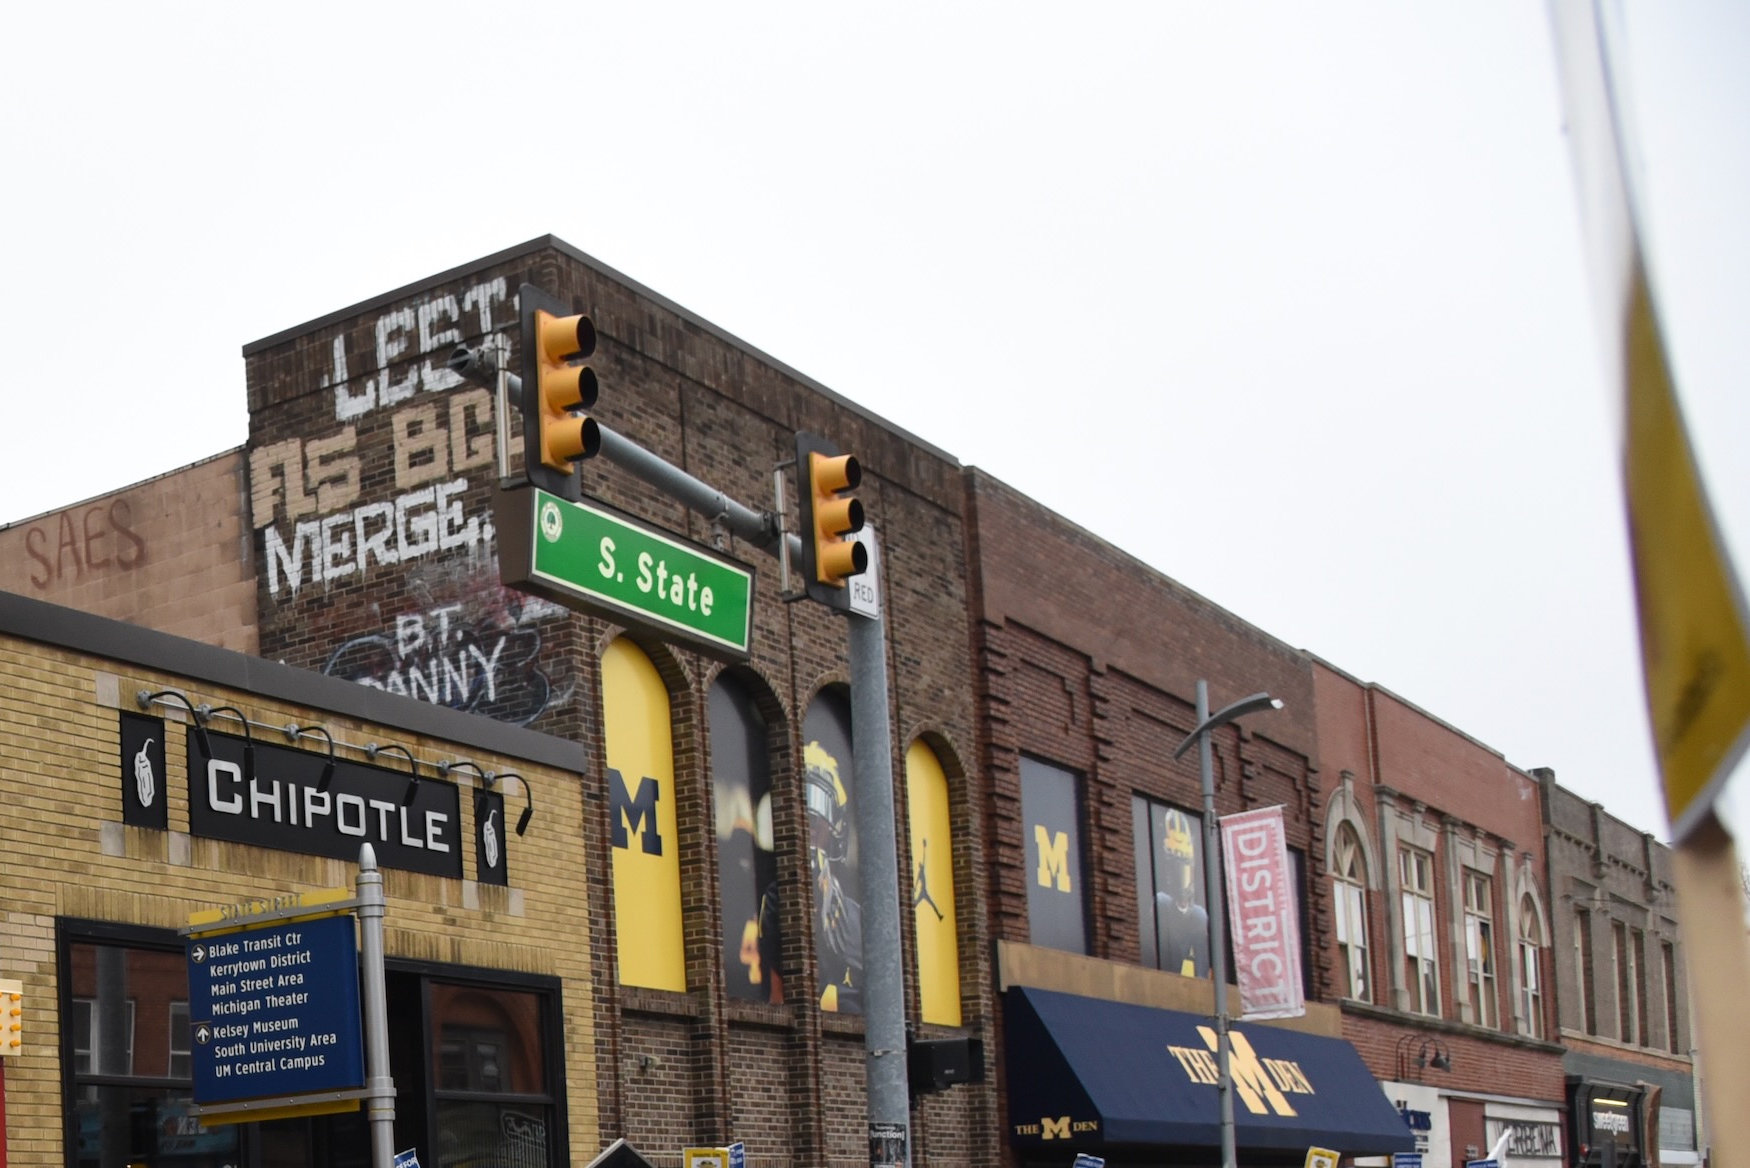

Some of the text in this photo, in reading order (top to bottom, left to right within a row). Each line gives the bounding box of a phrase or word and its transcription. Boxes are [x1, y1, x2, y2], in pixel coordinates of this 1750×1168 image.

[598, 537, 714, 617] S. State
[853, 582, 874, 603] RED
[207, 758, 450, 853] CHIPOTLE
[607, 767, 663, 857] M
[1033, 824, 1072, 893] M
[1237, 830, 1286, 1002] DISTRICT
[209, 932, 302, 959] Blake Transit Ctr
[210, 950, 311, 977] Kerrytown District
[211, 972, 304, 997] Main Street Area
[212, 992, 309, 1016] Michigan Theater
[213, 1017, 299, 1039] Kelsey Museum
[214, 1032, 337, 1058] South University Area
[215, 1053, 325, 1077] UM Central Campus
[1167, 1025, 1315, 1117] THE M DEN
[1014, 1116, 1098, 1140] THE M DEN
[1593, 1111, 1629, 1136] sweetgreen
